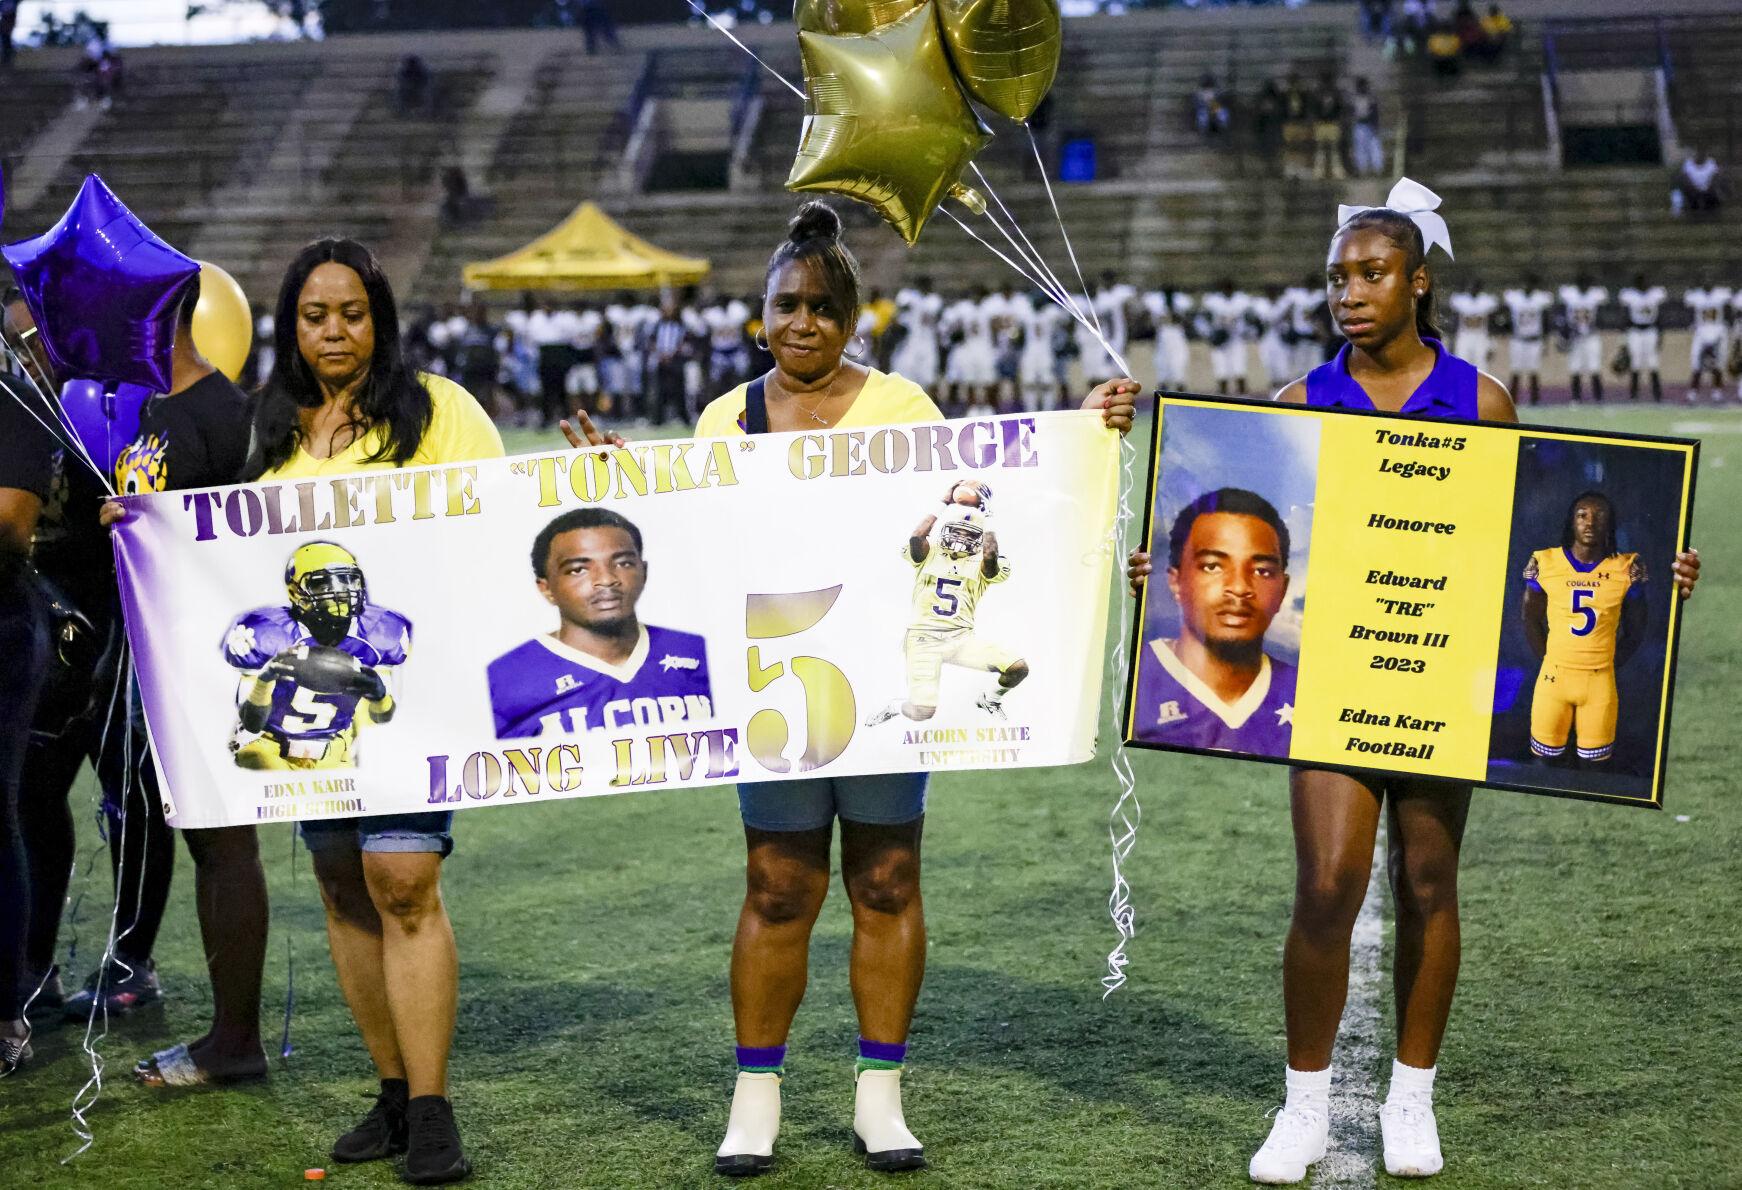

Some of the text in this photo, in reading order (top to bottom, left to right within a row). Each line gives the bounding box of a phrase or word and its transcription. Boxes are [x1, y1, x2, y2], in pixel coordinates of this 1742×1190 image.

[1375, 429, 1467, 451] Tonka#5
[183, 465, 481, 542] TOLLETTE
[787, 417, 1039, 480] GEORGE
[1378, 458, 1451, 481] Legacy
[1367, 513, 1456, 535] Honoree
[1365, 570, 1448, 591] Edward
[1566, 580, 1601, 588] COUGARS
[932, 577, 962, 617] 5
[1376, 597, 1435, 617] "TRE"
[1571, 589, 1597, 637] 5
[1349, 625, 1450, 648] Brown III
[1369, 655, 1426, 674] 2023
[427, 584, 857, 804] LONG LIVE 5
[281, 685, 339, 734] 5
[539, 694, 713, 736] ALCORN
[1338, 708, 1447, 733] Edna Karr
[902, 726, 1031, 745] ALCORN STATE
[919, 748, 1021, 765] UNIITY
[1344, 737, 1435, 760] FootBall
[263, 778, 356, 799] EDNA KARR
[256, 798, 367, 820] HIGH SCHOOL
